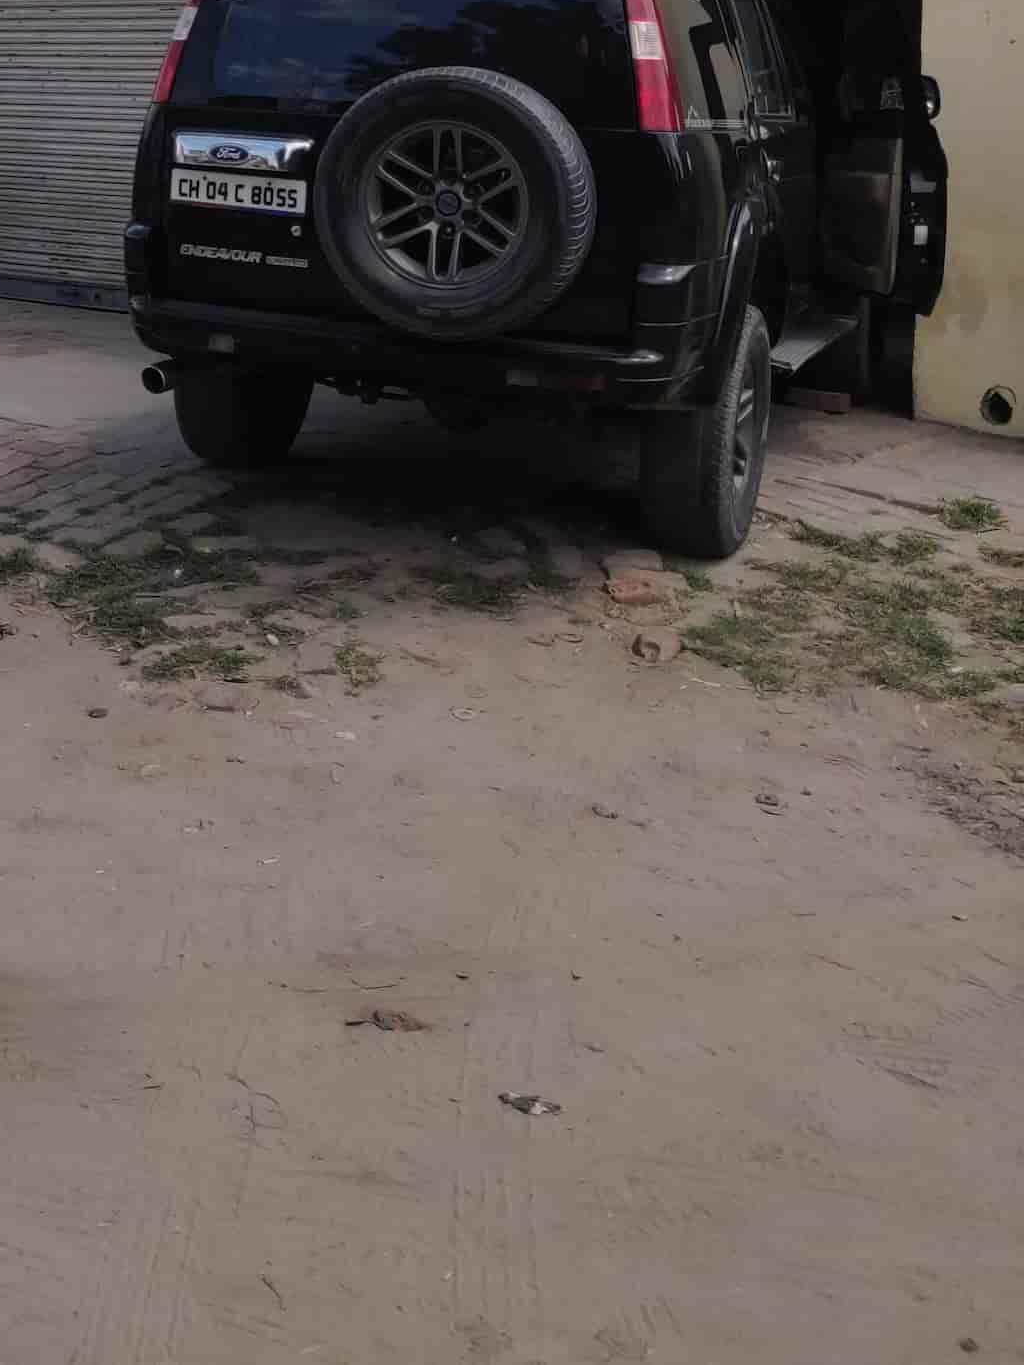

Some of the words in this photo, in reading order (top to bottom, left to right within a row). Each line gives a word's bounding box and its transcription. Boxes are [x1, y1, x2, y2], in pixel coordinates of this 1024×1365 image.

[178, 179, 199, 199] CH
[206, 181, 228, 201] 04
[235, 184, 244, 202] C
[180, 243, 263, 264] ENDEAVOUR
